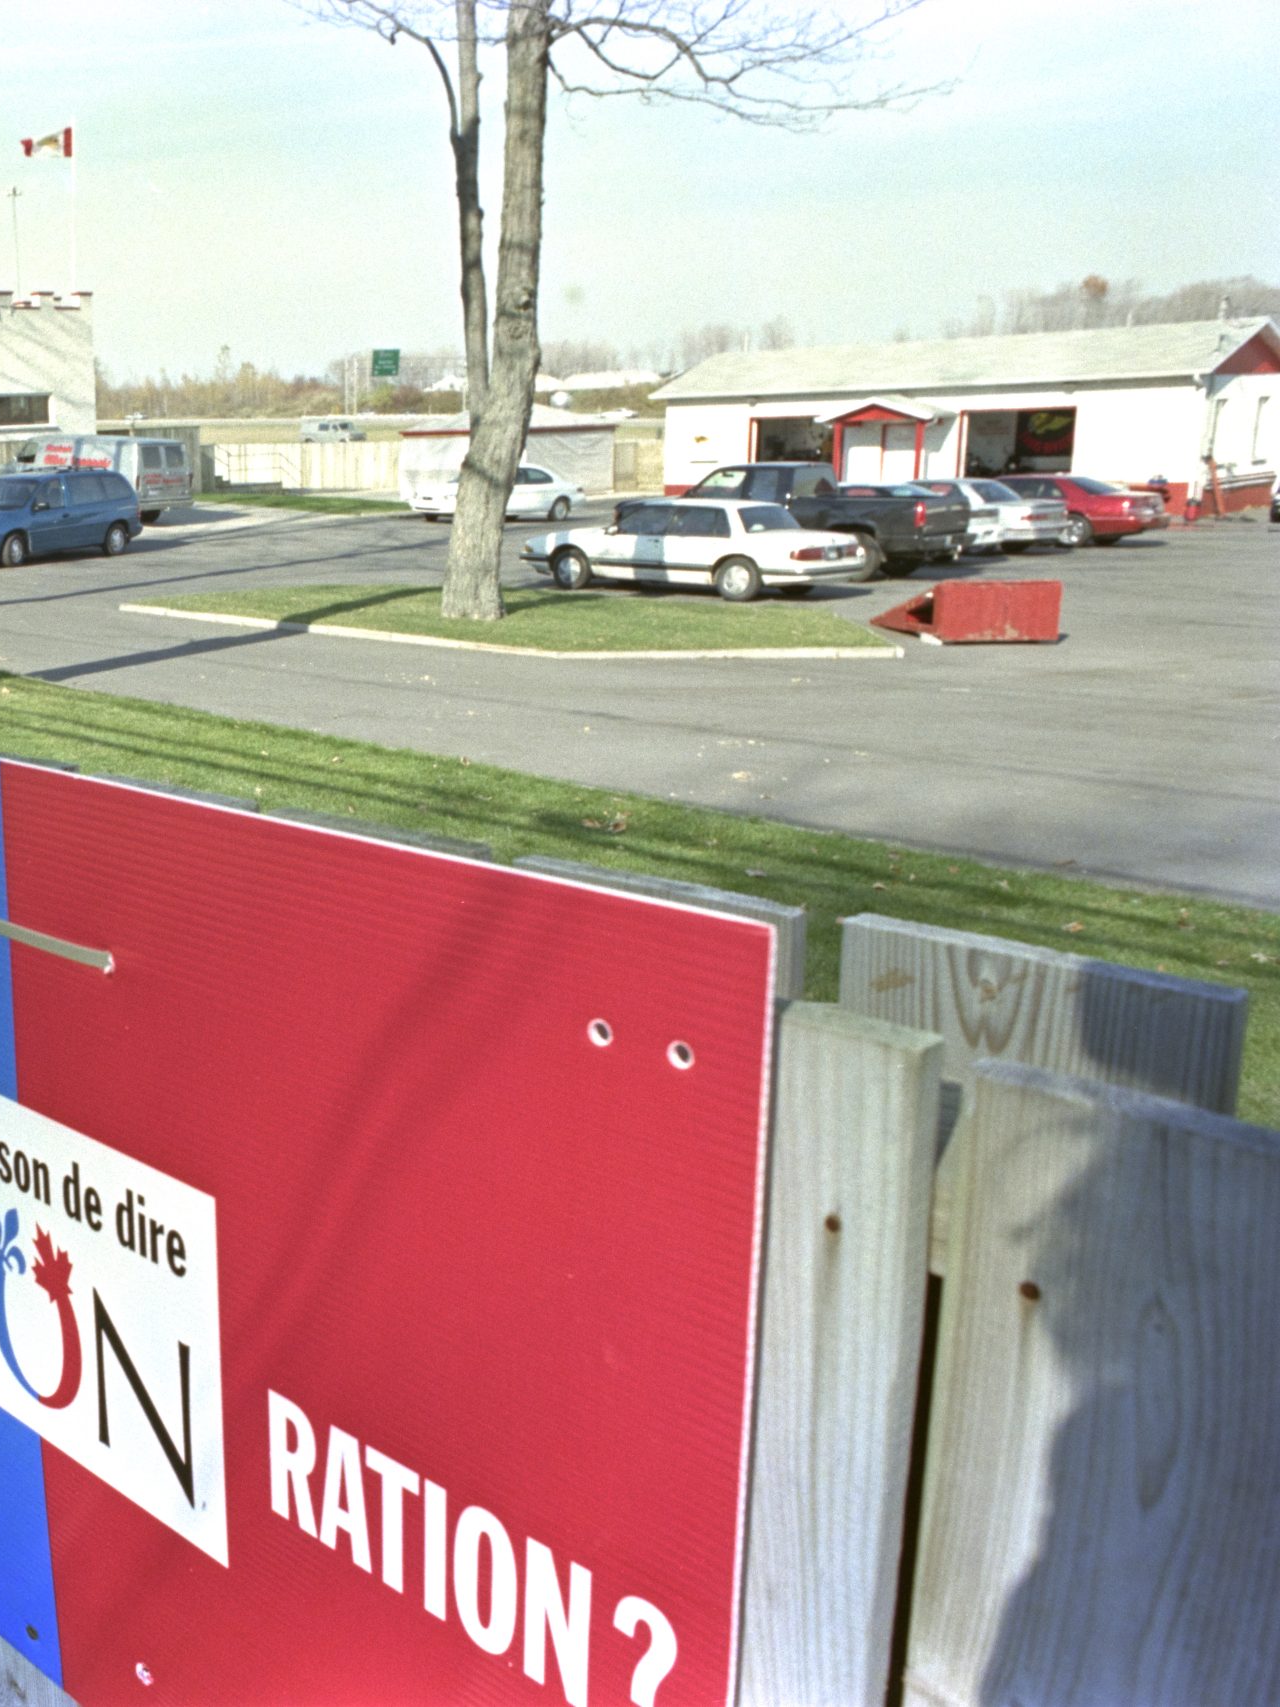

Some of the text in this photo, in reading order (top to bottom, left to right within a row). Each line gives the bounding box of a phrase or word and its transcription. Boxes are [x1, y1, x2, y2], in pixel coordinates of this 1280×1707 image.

[63, 1161, 103, 1232] de
[115, 1189, 187, 1278] dire
[268, 1388, 592, 1707] RATION
